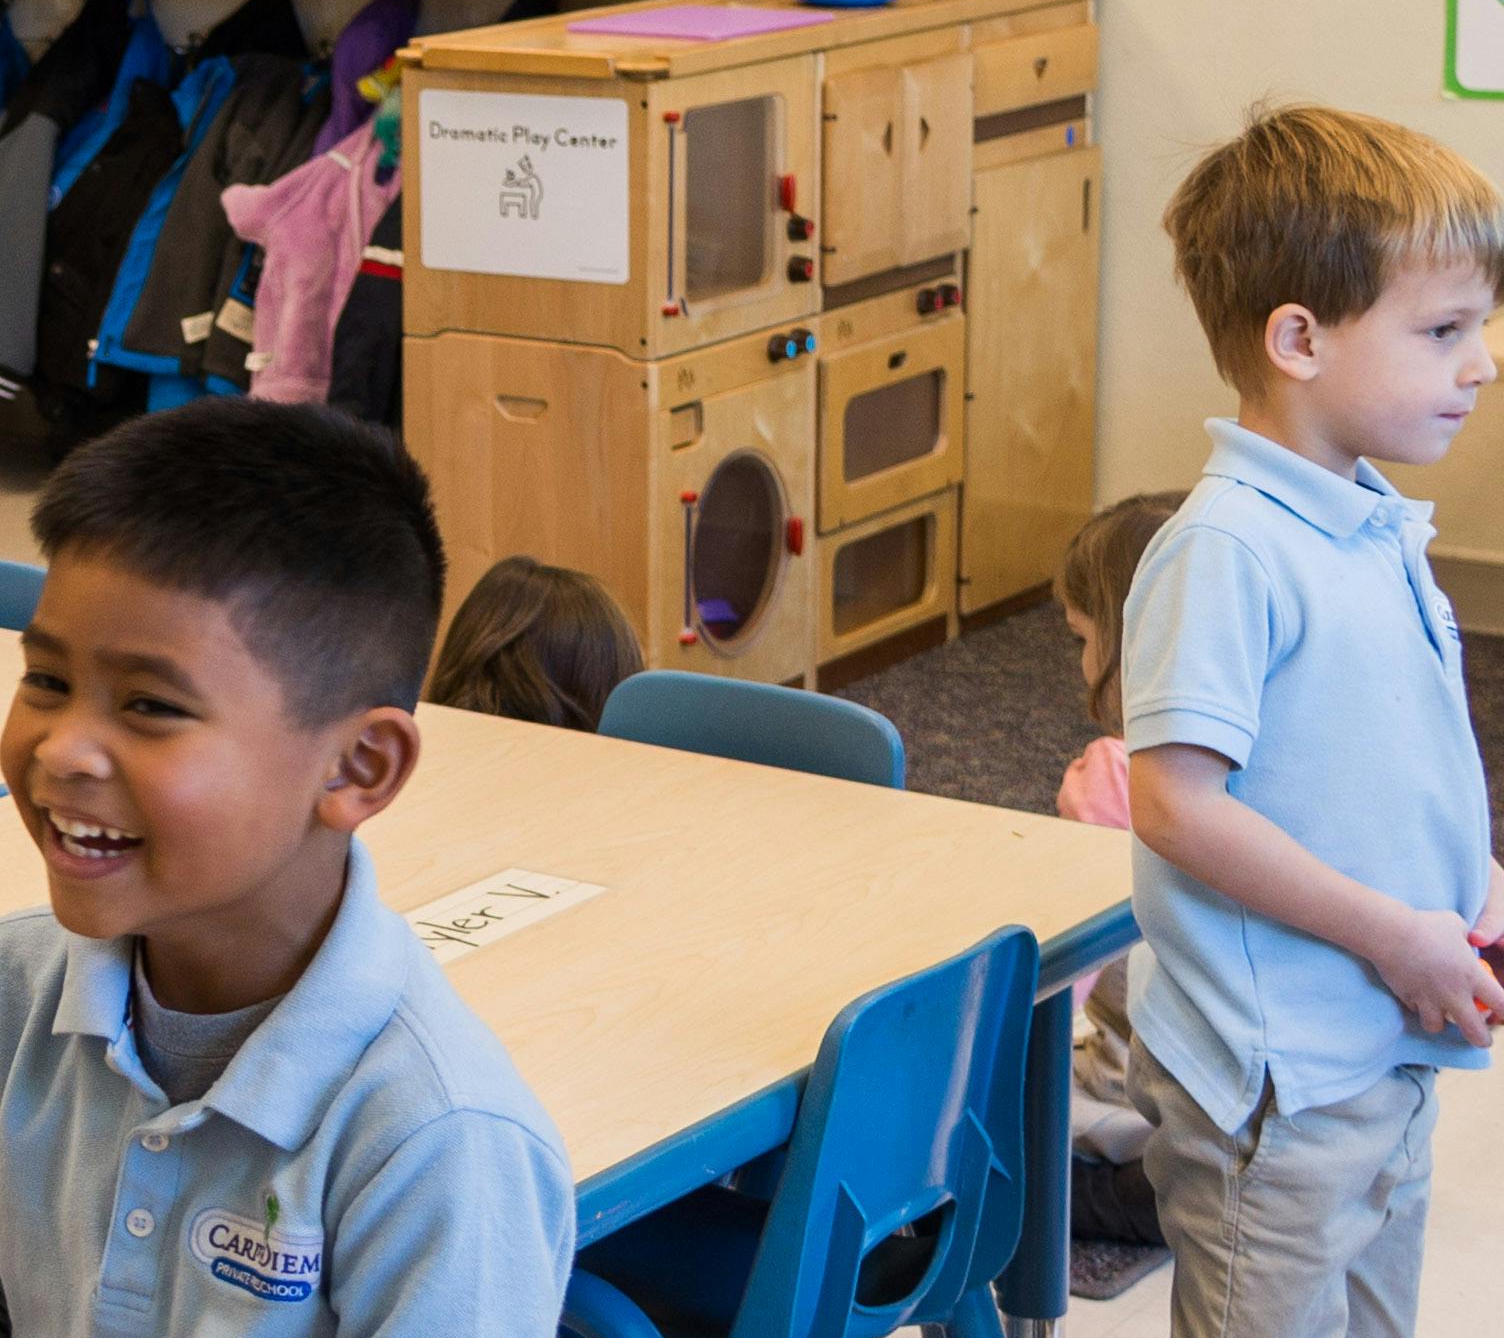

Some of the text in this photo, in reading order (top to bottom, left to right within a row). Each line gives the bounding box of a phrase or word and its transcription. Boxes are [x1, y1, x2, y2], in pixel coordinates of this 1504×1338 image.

[429, 120, 618, 151] Dramatic Play Center
[416, 906, 505, 949] yler
